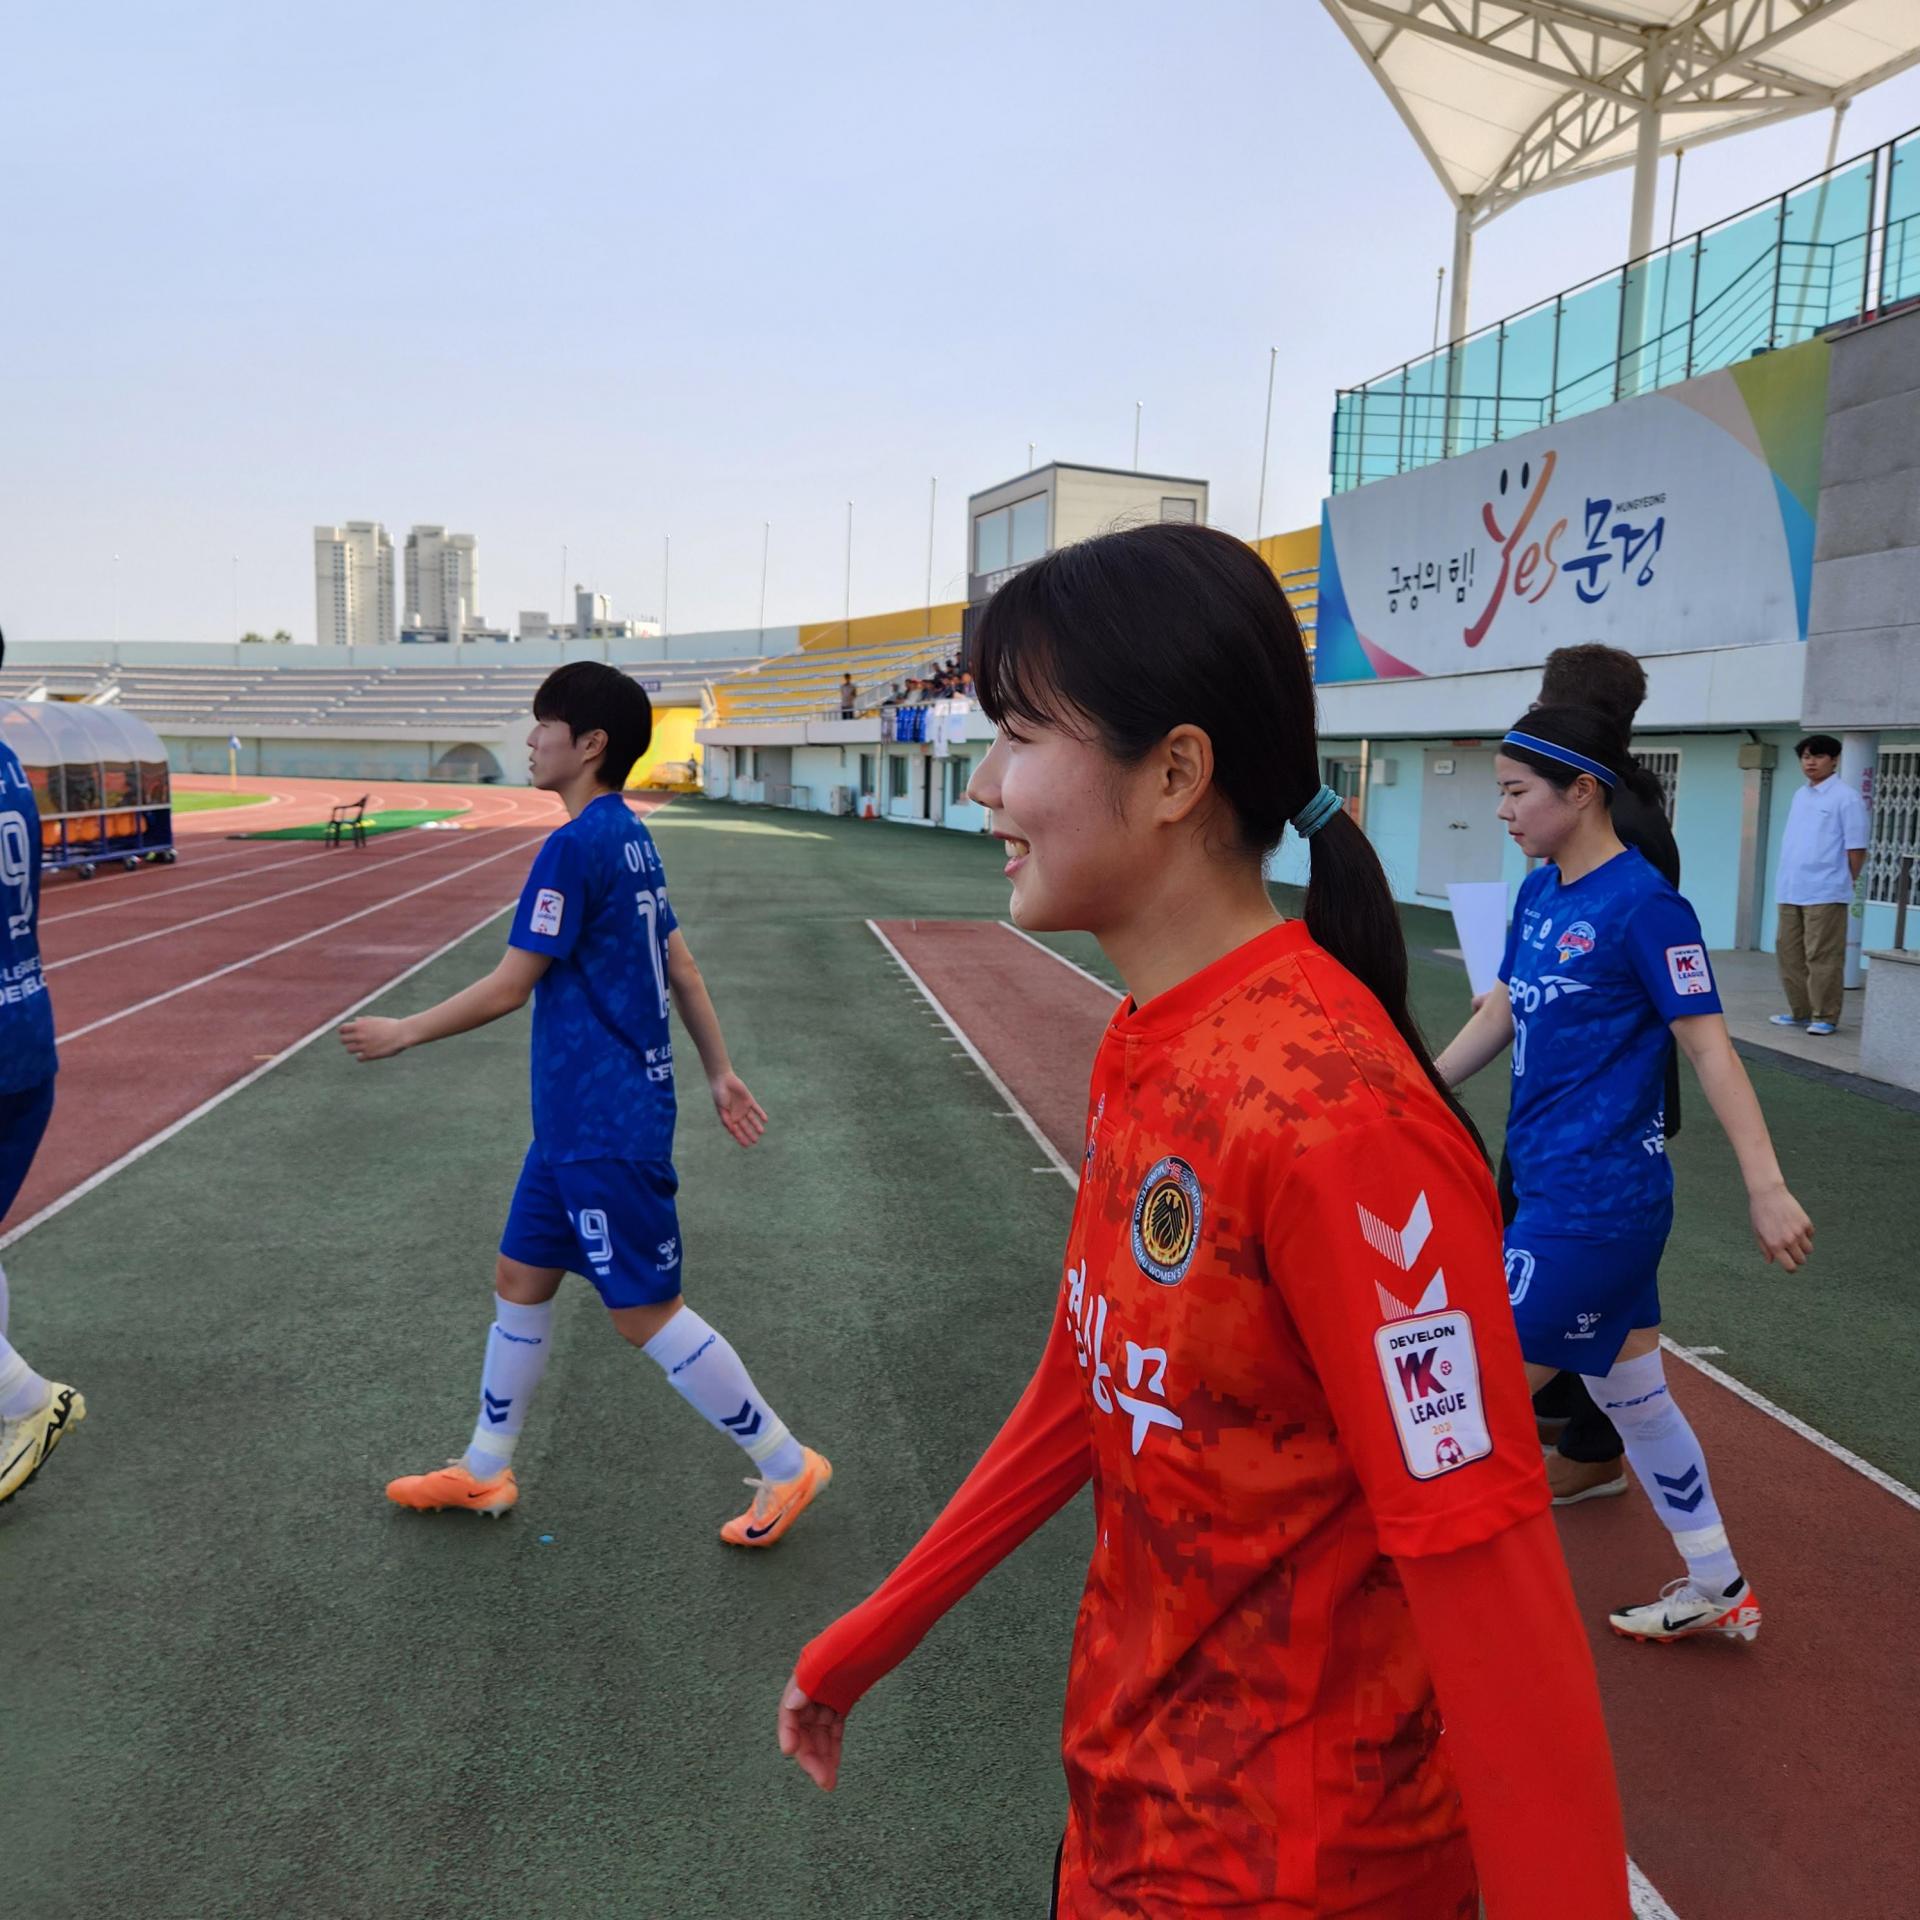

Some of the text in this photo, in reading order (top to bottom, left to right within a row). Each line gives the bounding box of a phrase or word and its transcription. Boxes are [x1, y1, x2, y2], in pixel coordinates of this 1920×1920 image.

[1615, 493, 1666, 513] MUNGYEONG
[1562, 498, 1665, 603] 문경
[1388, 548, 1475, 613] 긍정의 힘!
[1390, 1325, 1455, 1350] DEVELON
[1410, 1392, 1467, 1425] LEAGUE
